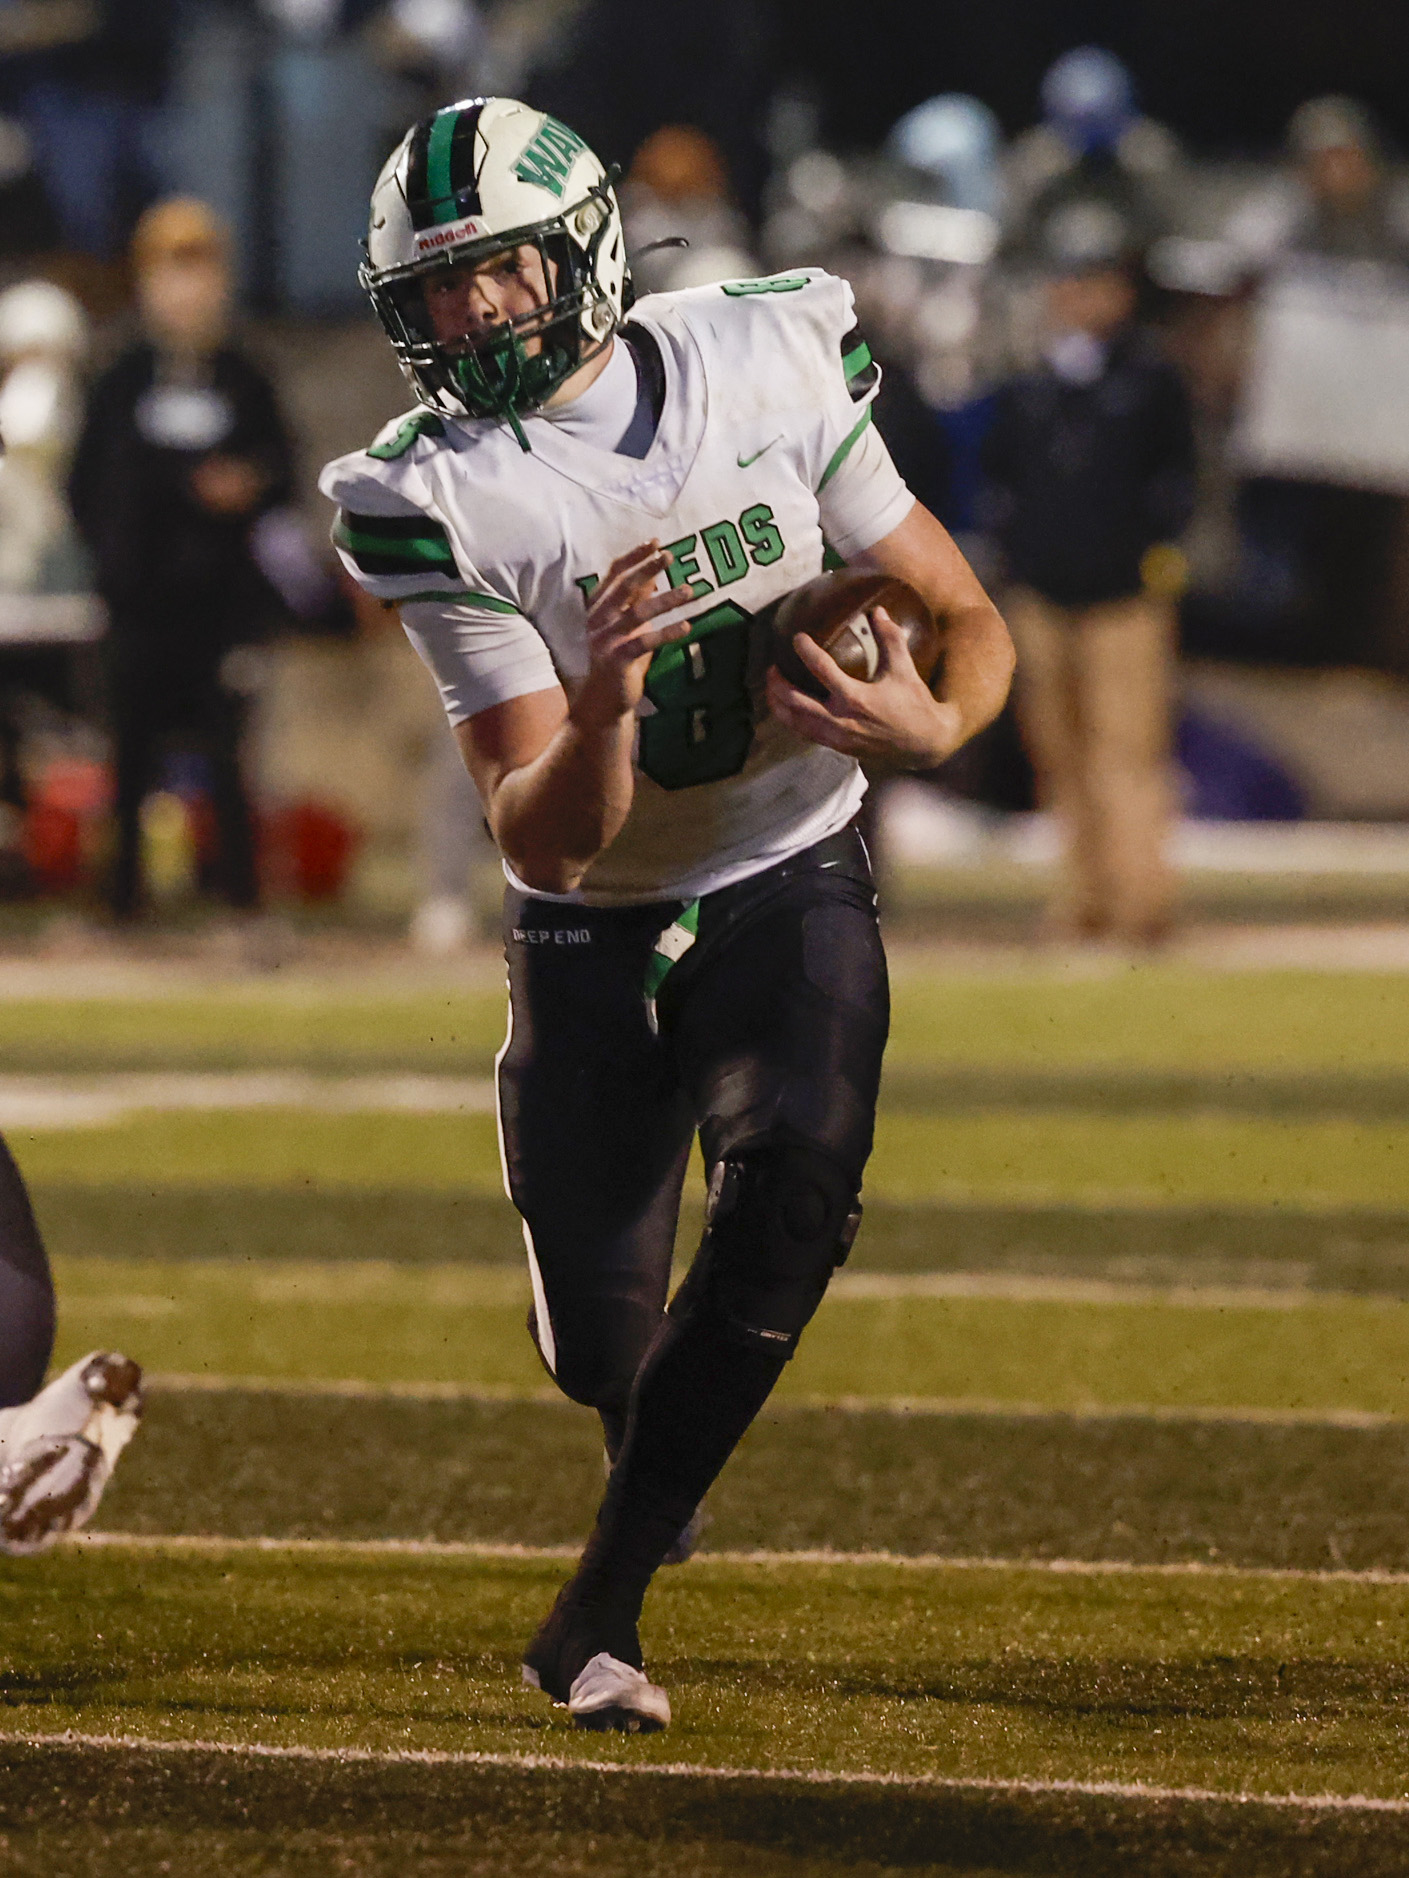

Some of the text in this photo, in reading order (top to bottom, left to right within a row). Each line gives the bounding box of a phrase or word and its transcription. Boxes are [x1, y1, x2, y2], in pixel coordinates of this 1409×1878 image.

[418, 221, 478, 251] Riddell
[575, 503, 785, 610] EDS
[638, 598, 754, 791] 8
[554, 928, 591, 945] END
